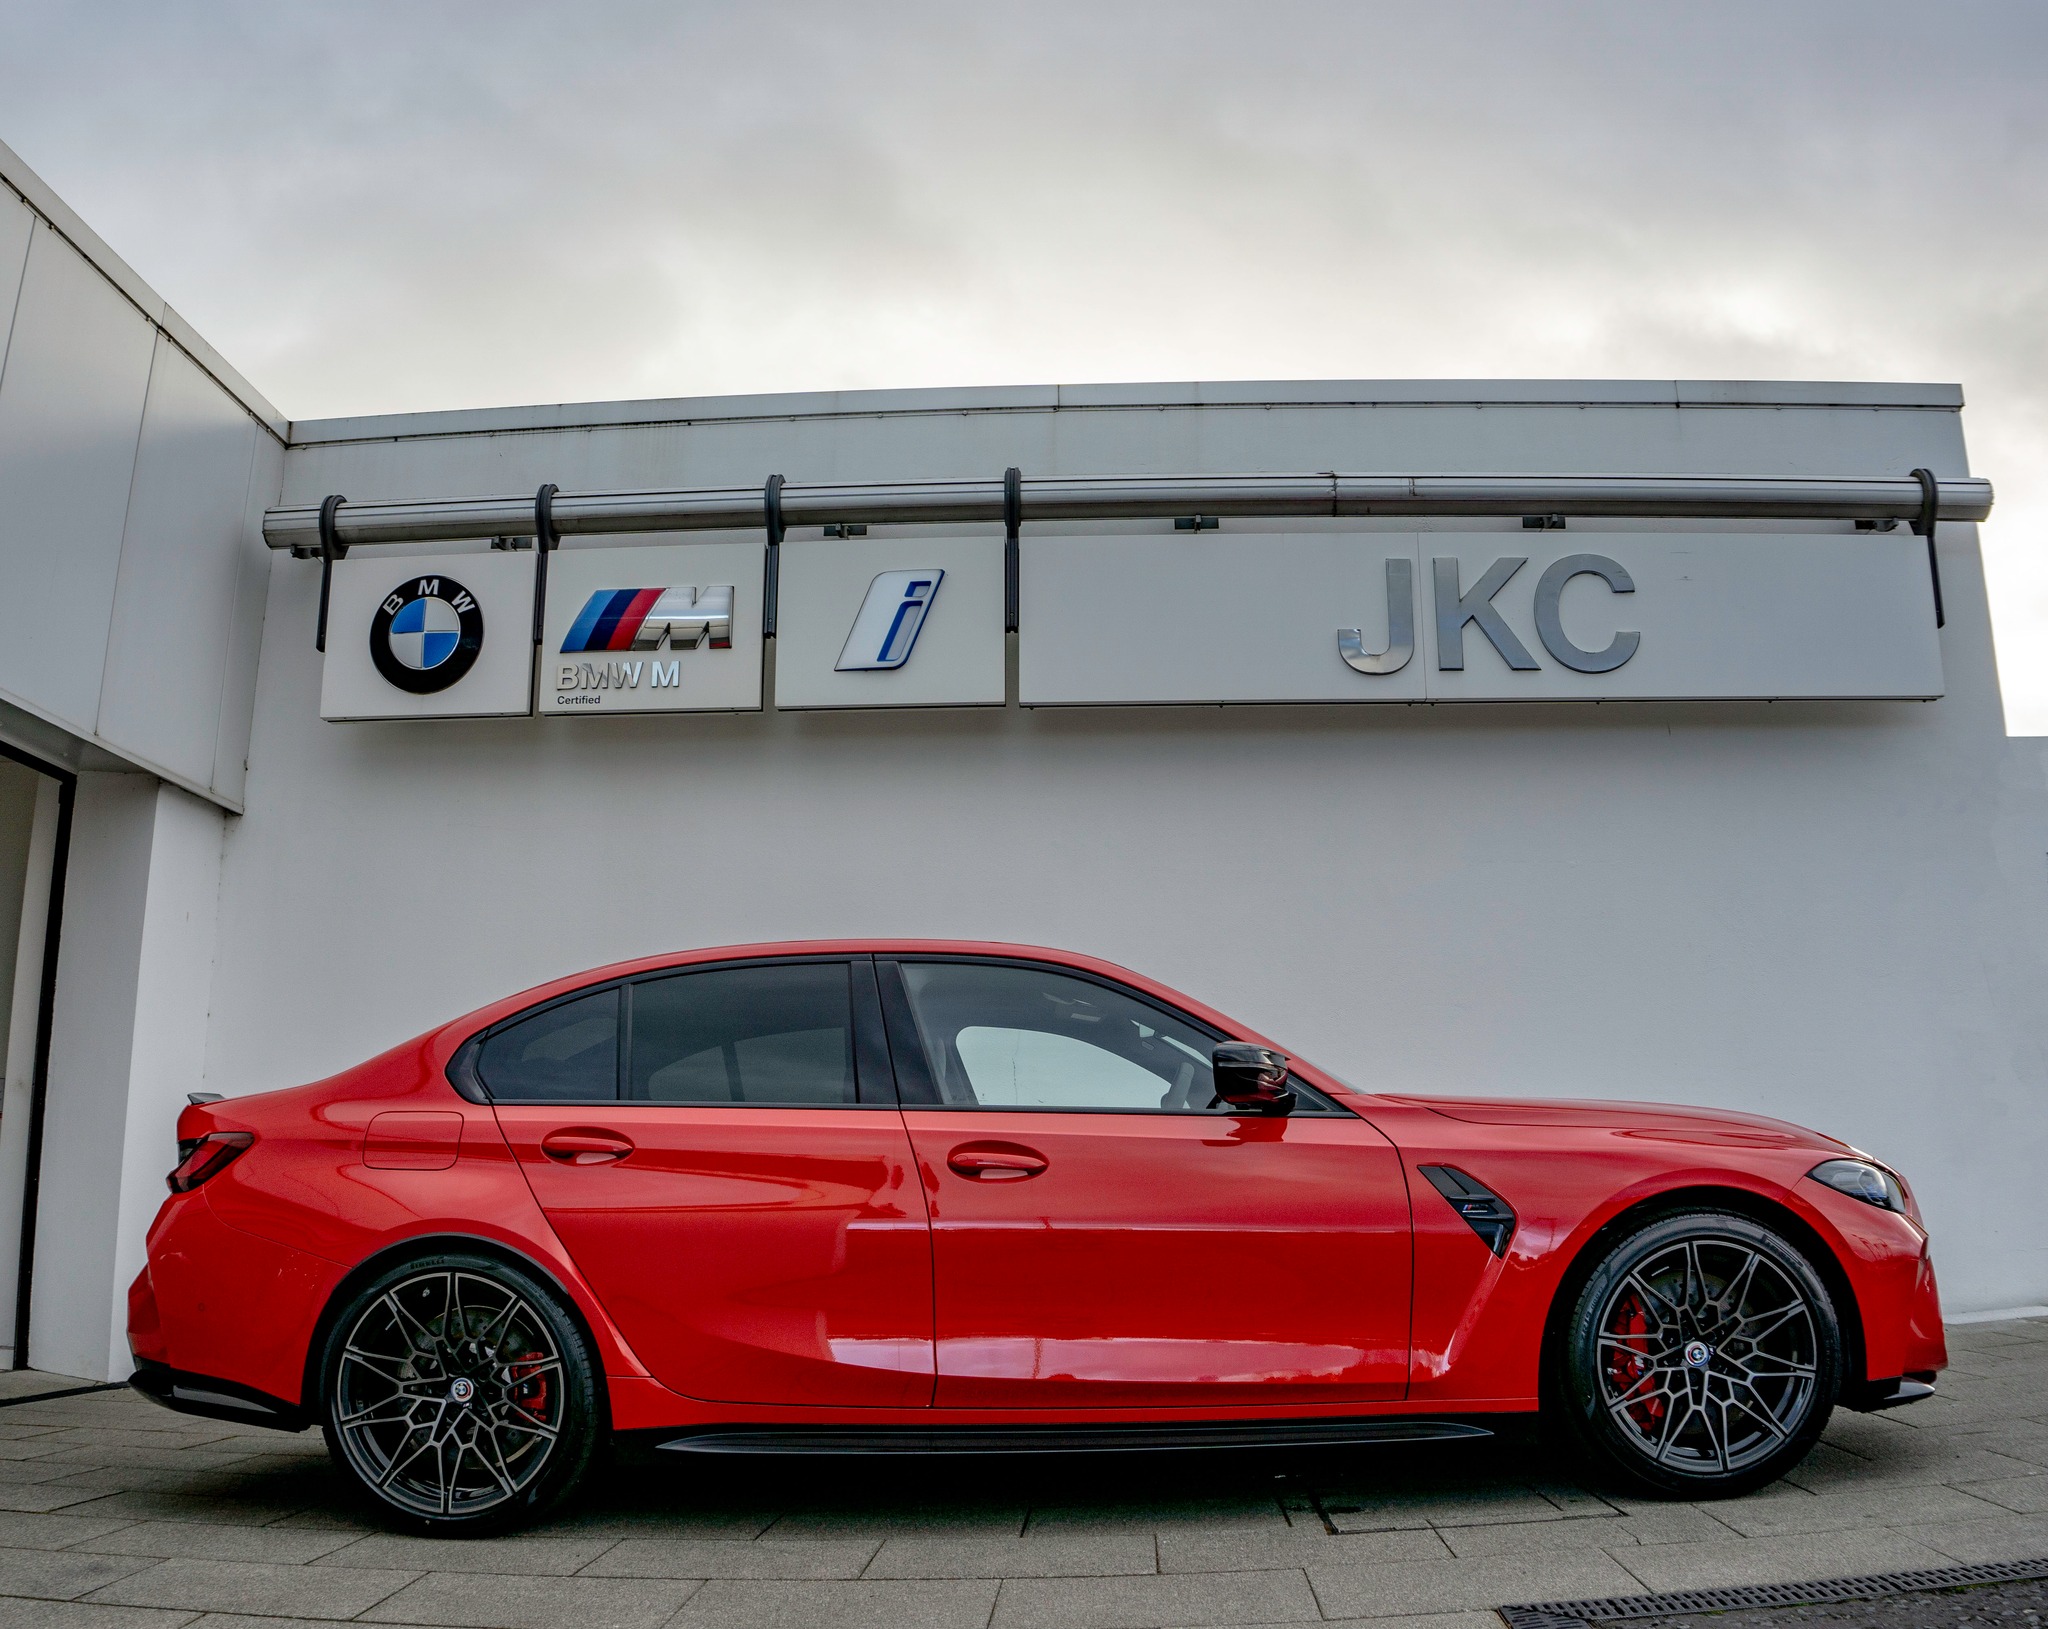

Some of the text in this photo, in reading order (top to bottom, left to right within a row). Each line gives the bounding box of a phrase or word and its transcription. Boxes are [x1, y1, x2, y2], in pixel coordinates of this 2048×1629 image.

[382, 579, 476, 615] BMW
[1337, 553, 1641, 676] JKC
[556, 660, 681, 691] BMW M
[557, 695, 601, 705] Certified
